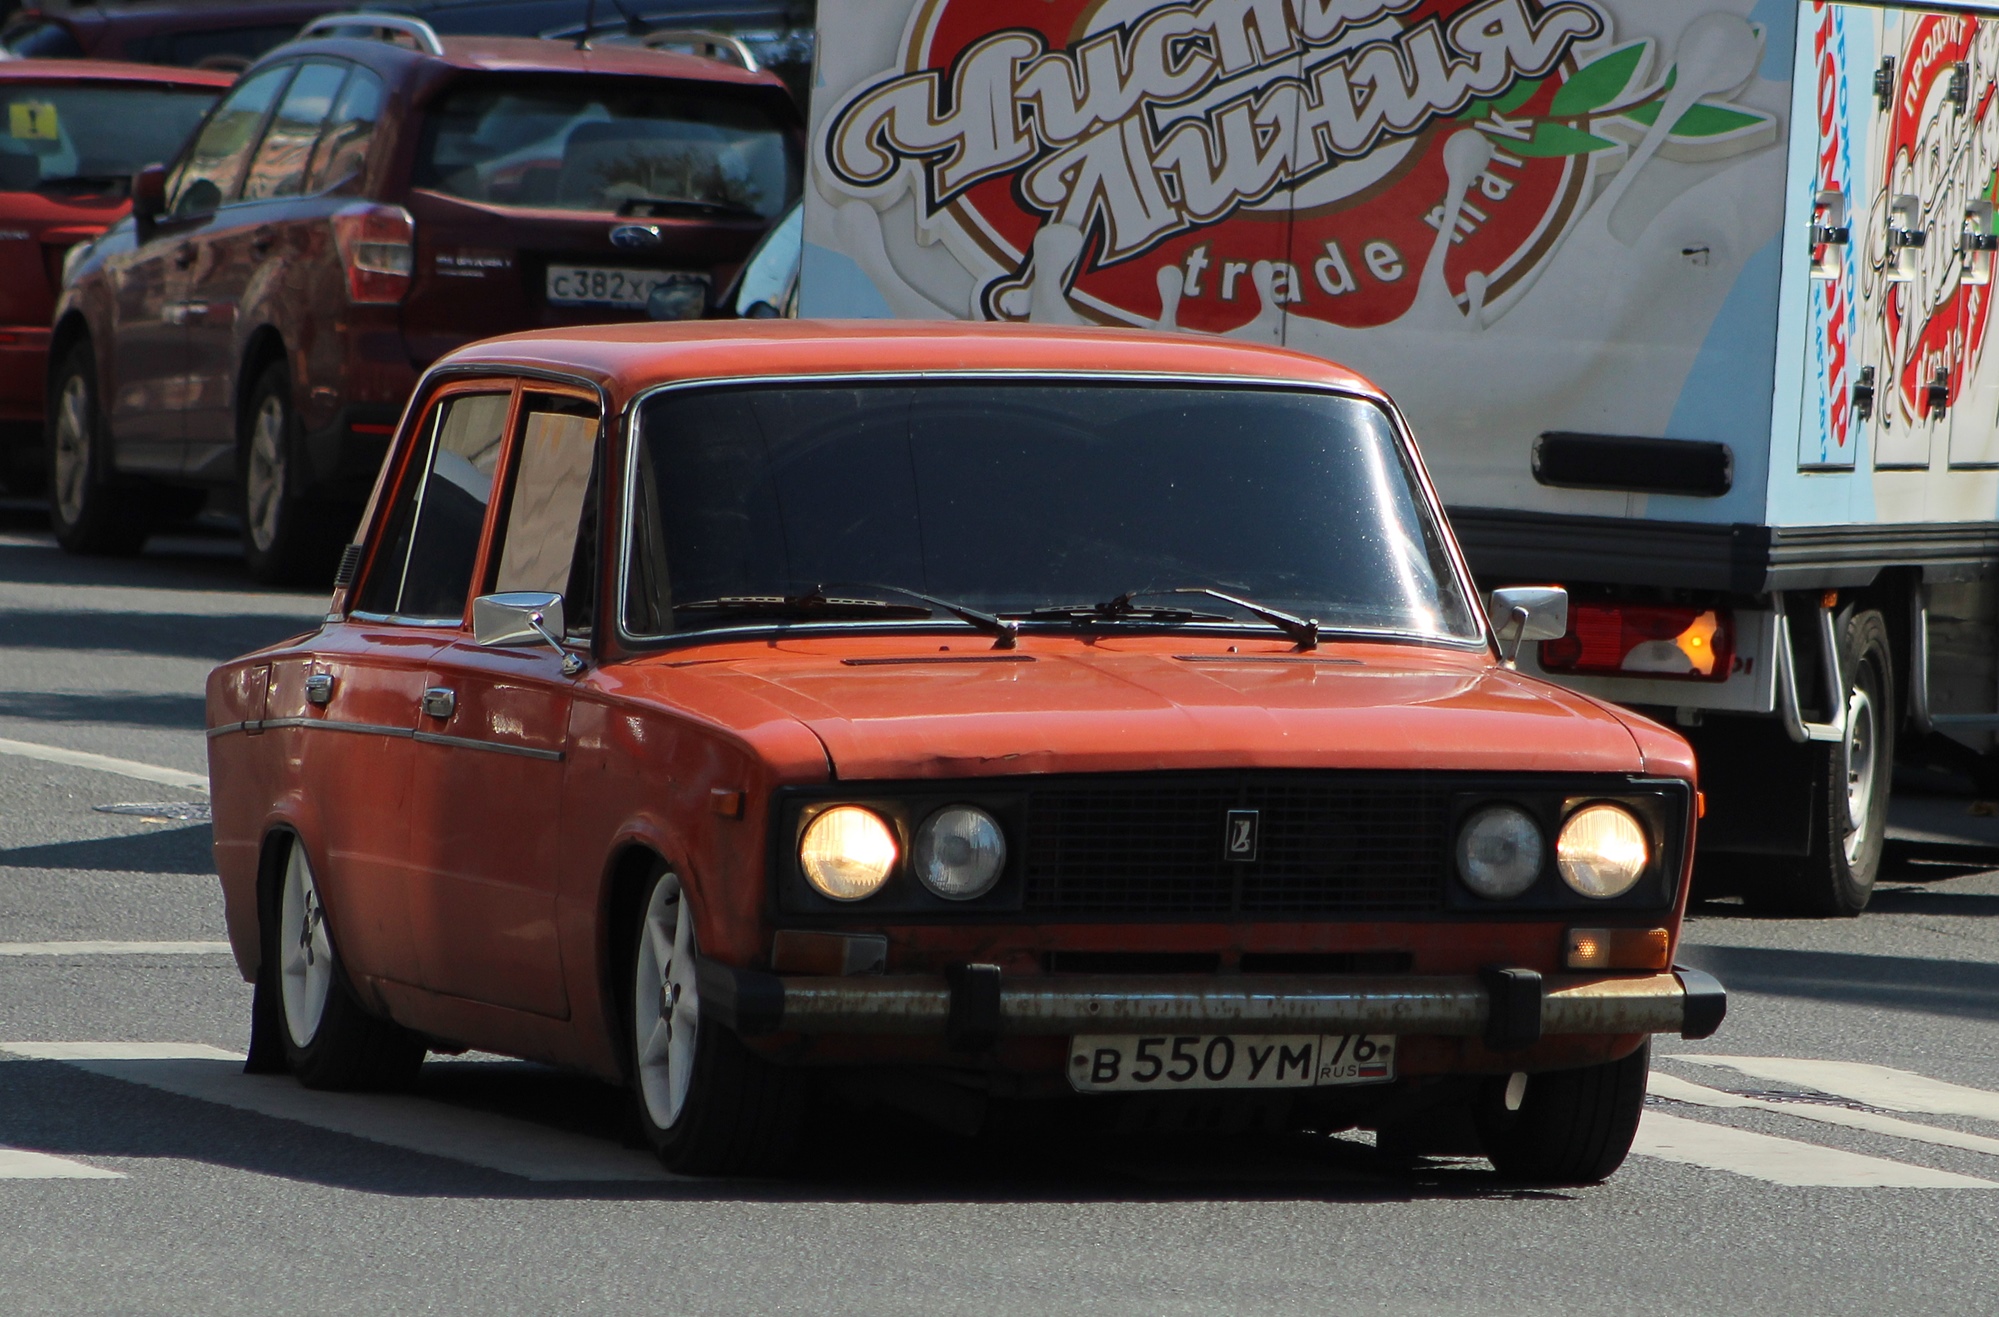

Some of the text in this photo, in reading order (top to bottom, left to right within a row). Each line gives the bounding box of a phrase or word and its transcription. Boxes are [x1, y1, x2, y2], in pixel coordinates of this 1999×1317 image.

[826, 0, 1418, 214] Чиста
[984, 0, 1604, 320] Линия
[1904, 15, 1967, 118] ПРОДУКТ
[1183, 241, 1403, 304] trade
[1813, 1, 1847, 448] ЛОМБИР
[1835, 4, 1856, 347] ОРОЖЕНОЕ
[1319, 1064, 1358, 1080] RUS
